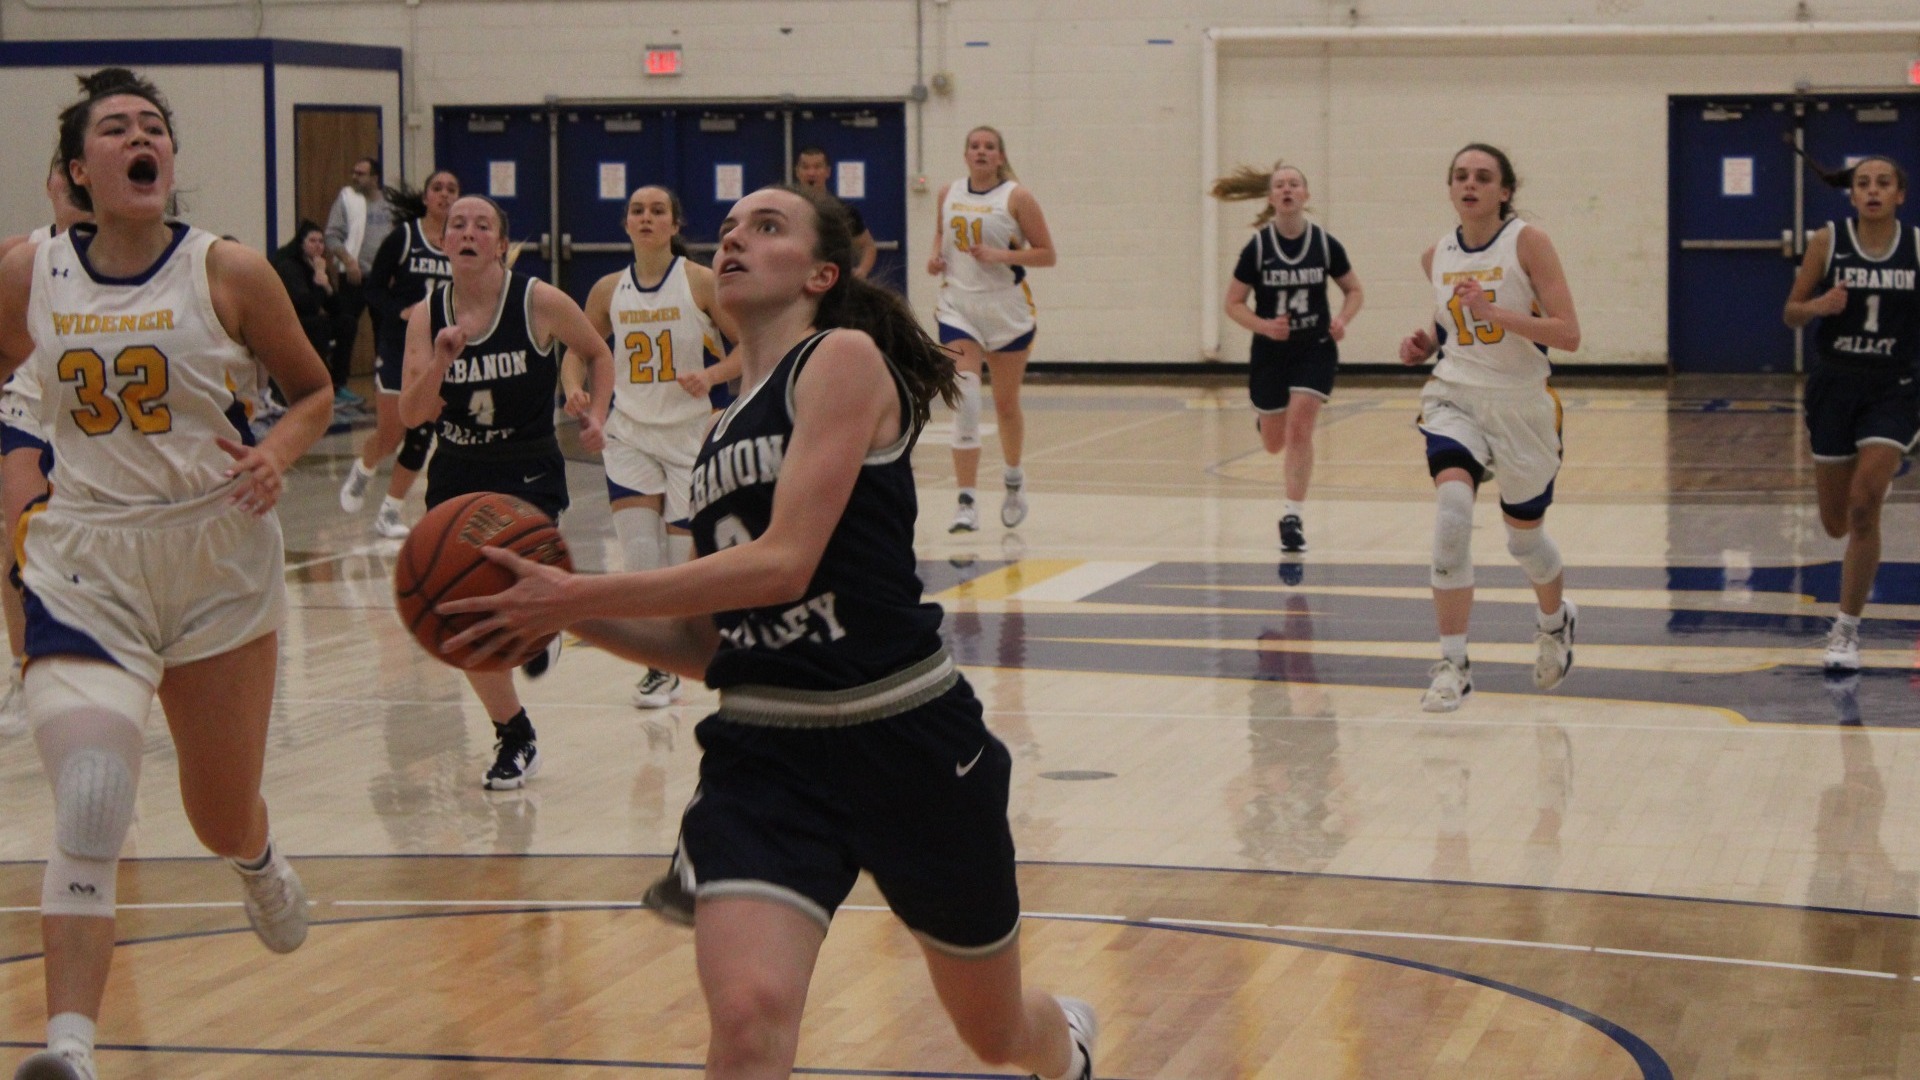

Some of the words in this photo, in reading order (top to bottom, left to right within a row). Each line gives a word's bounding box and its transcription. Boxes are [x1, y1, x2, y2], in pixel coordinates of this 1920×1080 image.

[950, 216, 983, 252] 31
[1262, 267, 1325, 286] LEBANON
[1834, 267, 1916, 290] LEBANON
[619, 306, 681, 324] WIDENER
[1276, 289, 1309, 316] 14
[1447, 289, 1505, 346] 15
[1864, 294, 1880, 333] 1
[52, 308, 175, 336] WIDENER
[444, 350, 528, 384] EBANON
[624, 329, 677, 384] 21
[57, 344, 173, 437] 32
[467, 389, 496, 426] 4
